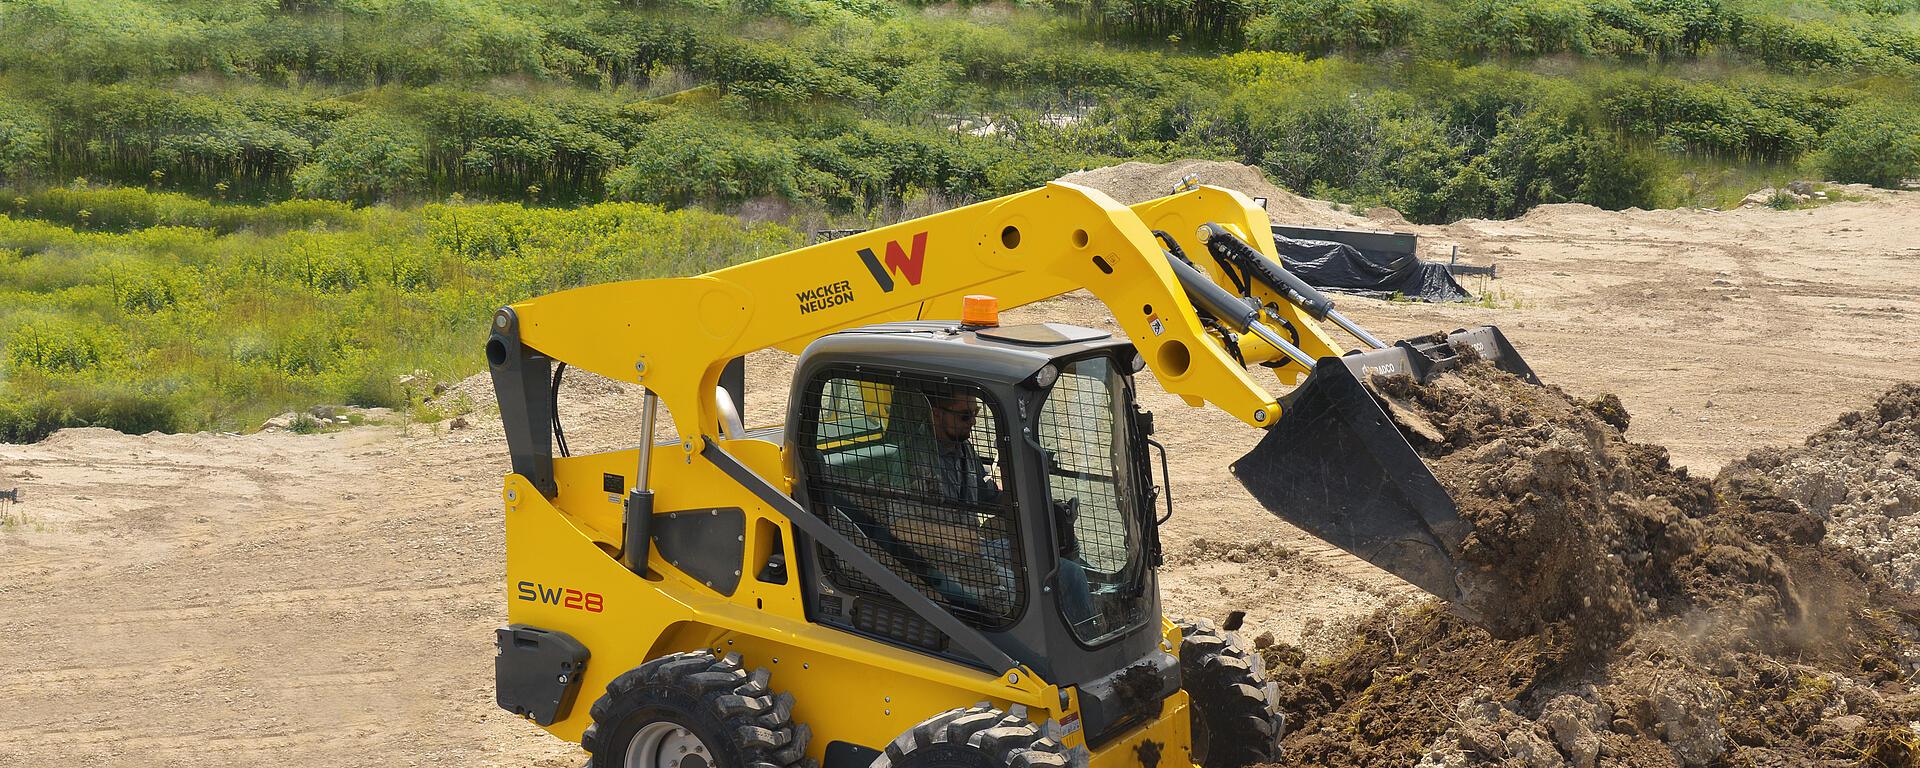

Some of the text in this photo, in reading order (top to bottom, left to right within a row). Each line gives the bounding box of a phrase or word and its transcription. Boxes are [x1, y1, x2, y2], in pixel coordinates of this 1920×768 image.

[856, 231, 928, 293] W
[796, 280, 852, 303] WACKER
[800, 291, 854, 315] NEUSON
[518, 581, 603, 613] SW28
